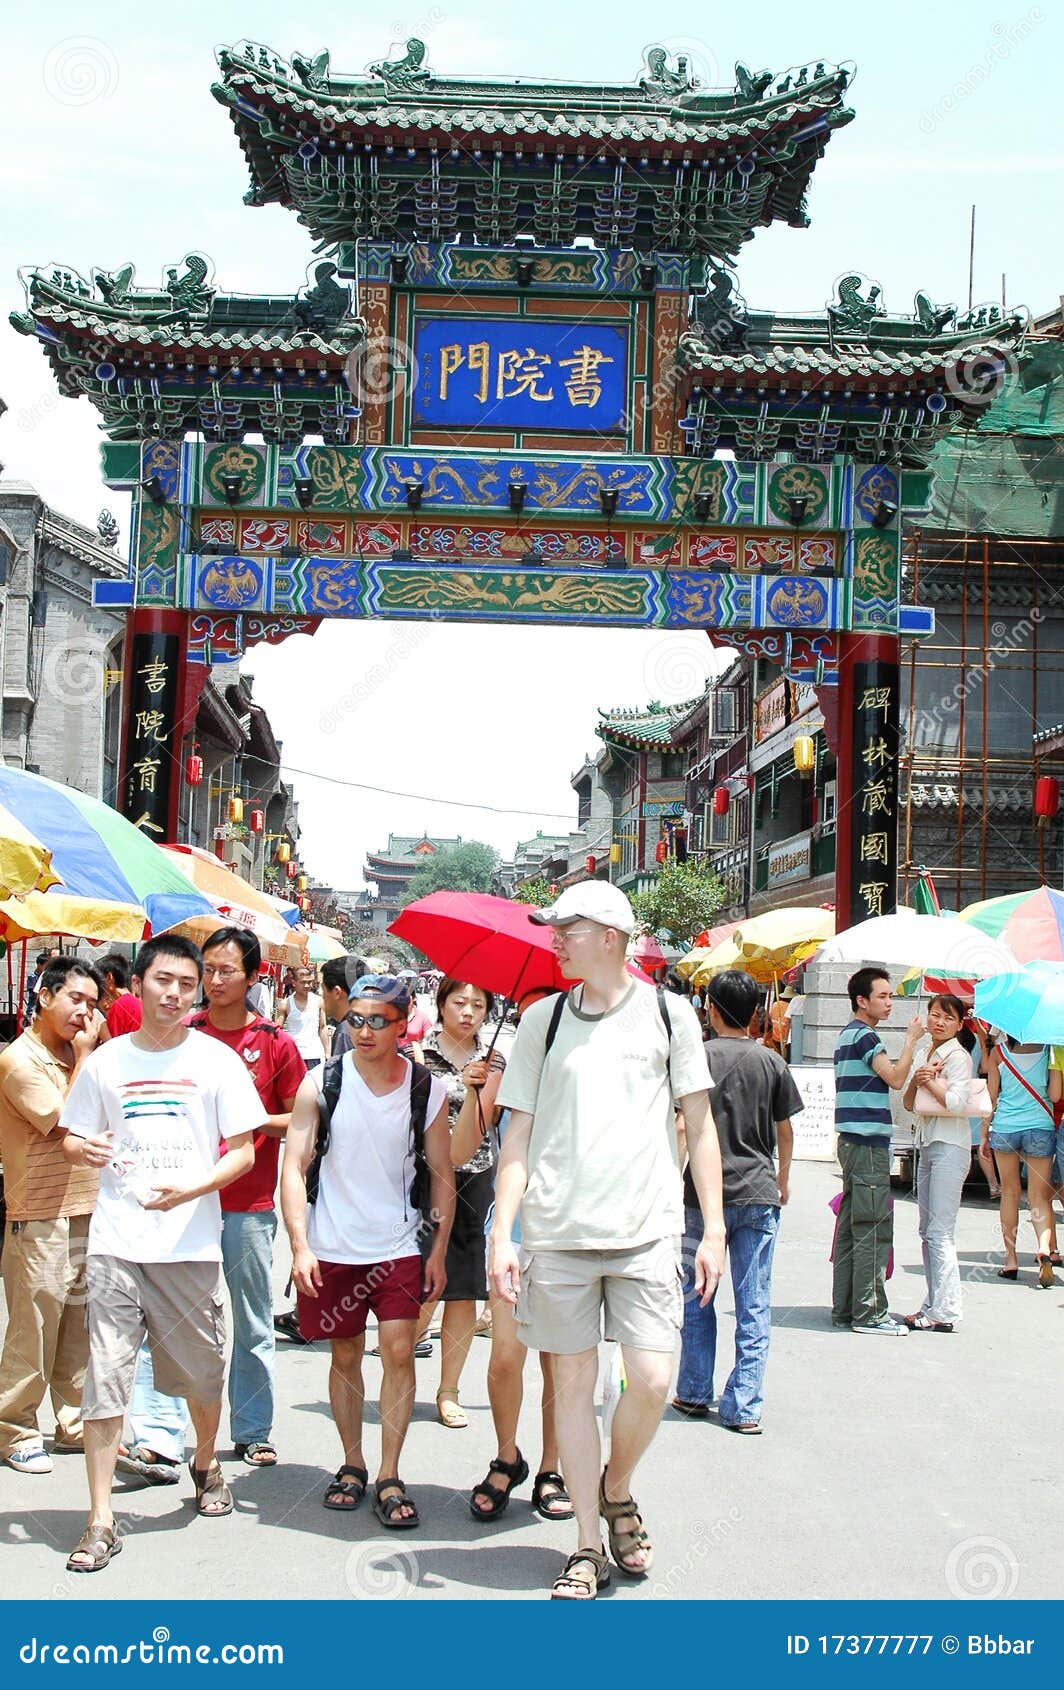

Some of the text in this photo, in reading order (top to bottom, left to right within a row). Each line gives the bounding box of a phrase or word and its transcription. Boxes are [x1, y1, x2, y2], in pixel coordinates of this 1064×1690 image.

[439, 341, 614, 408] 書院門
[133, 655, 169, 833] 書院育人
